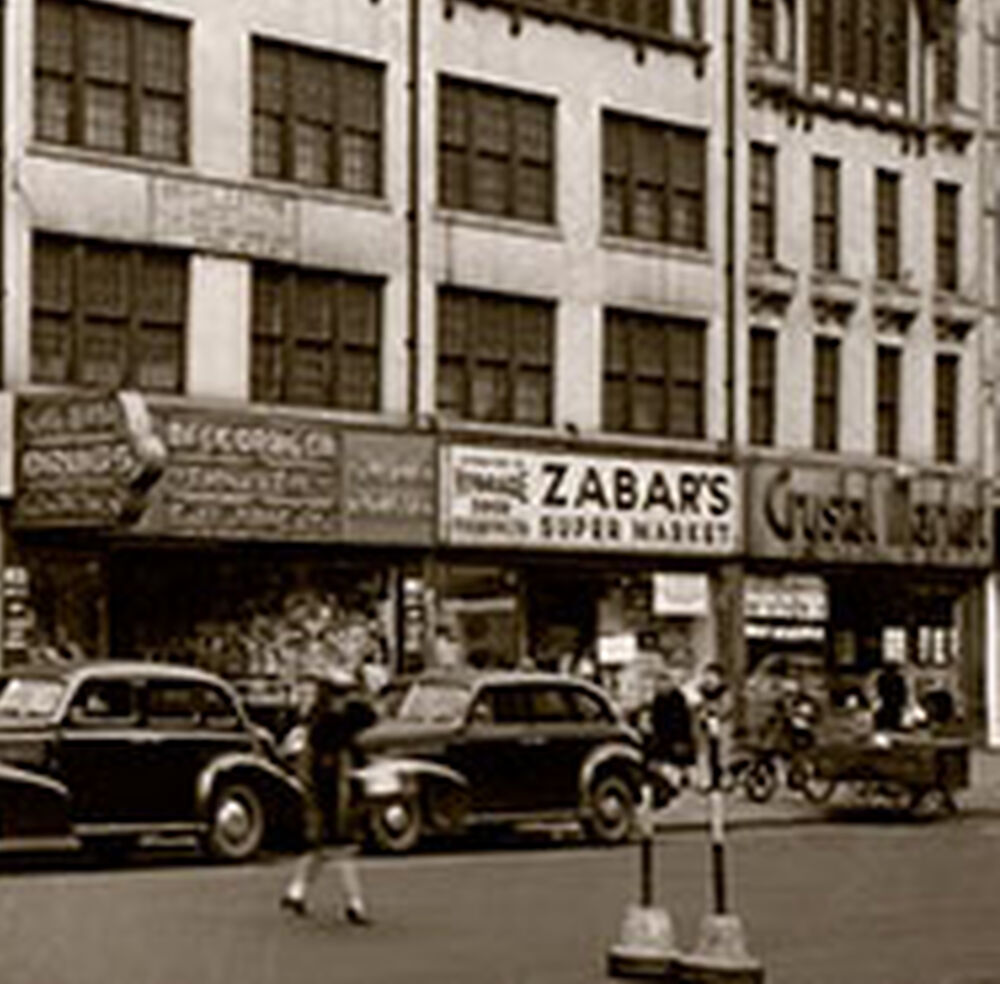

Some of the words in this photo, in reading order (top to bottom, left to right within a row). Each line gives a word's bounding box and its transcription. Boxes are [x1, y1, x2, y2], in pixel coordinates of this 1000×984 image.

[541, 464, 731, 516] ZABAR'S
[540, 515, 620, 541] SUPER
[632, 521, 731, 545] MARKET
